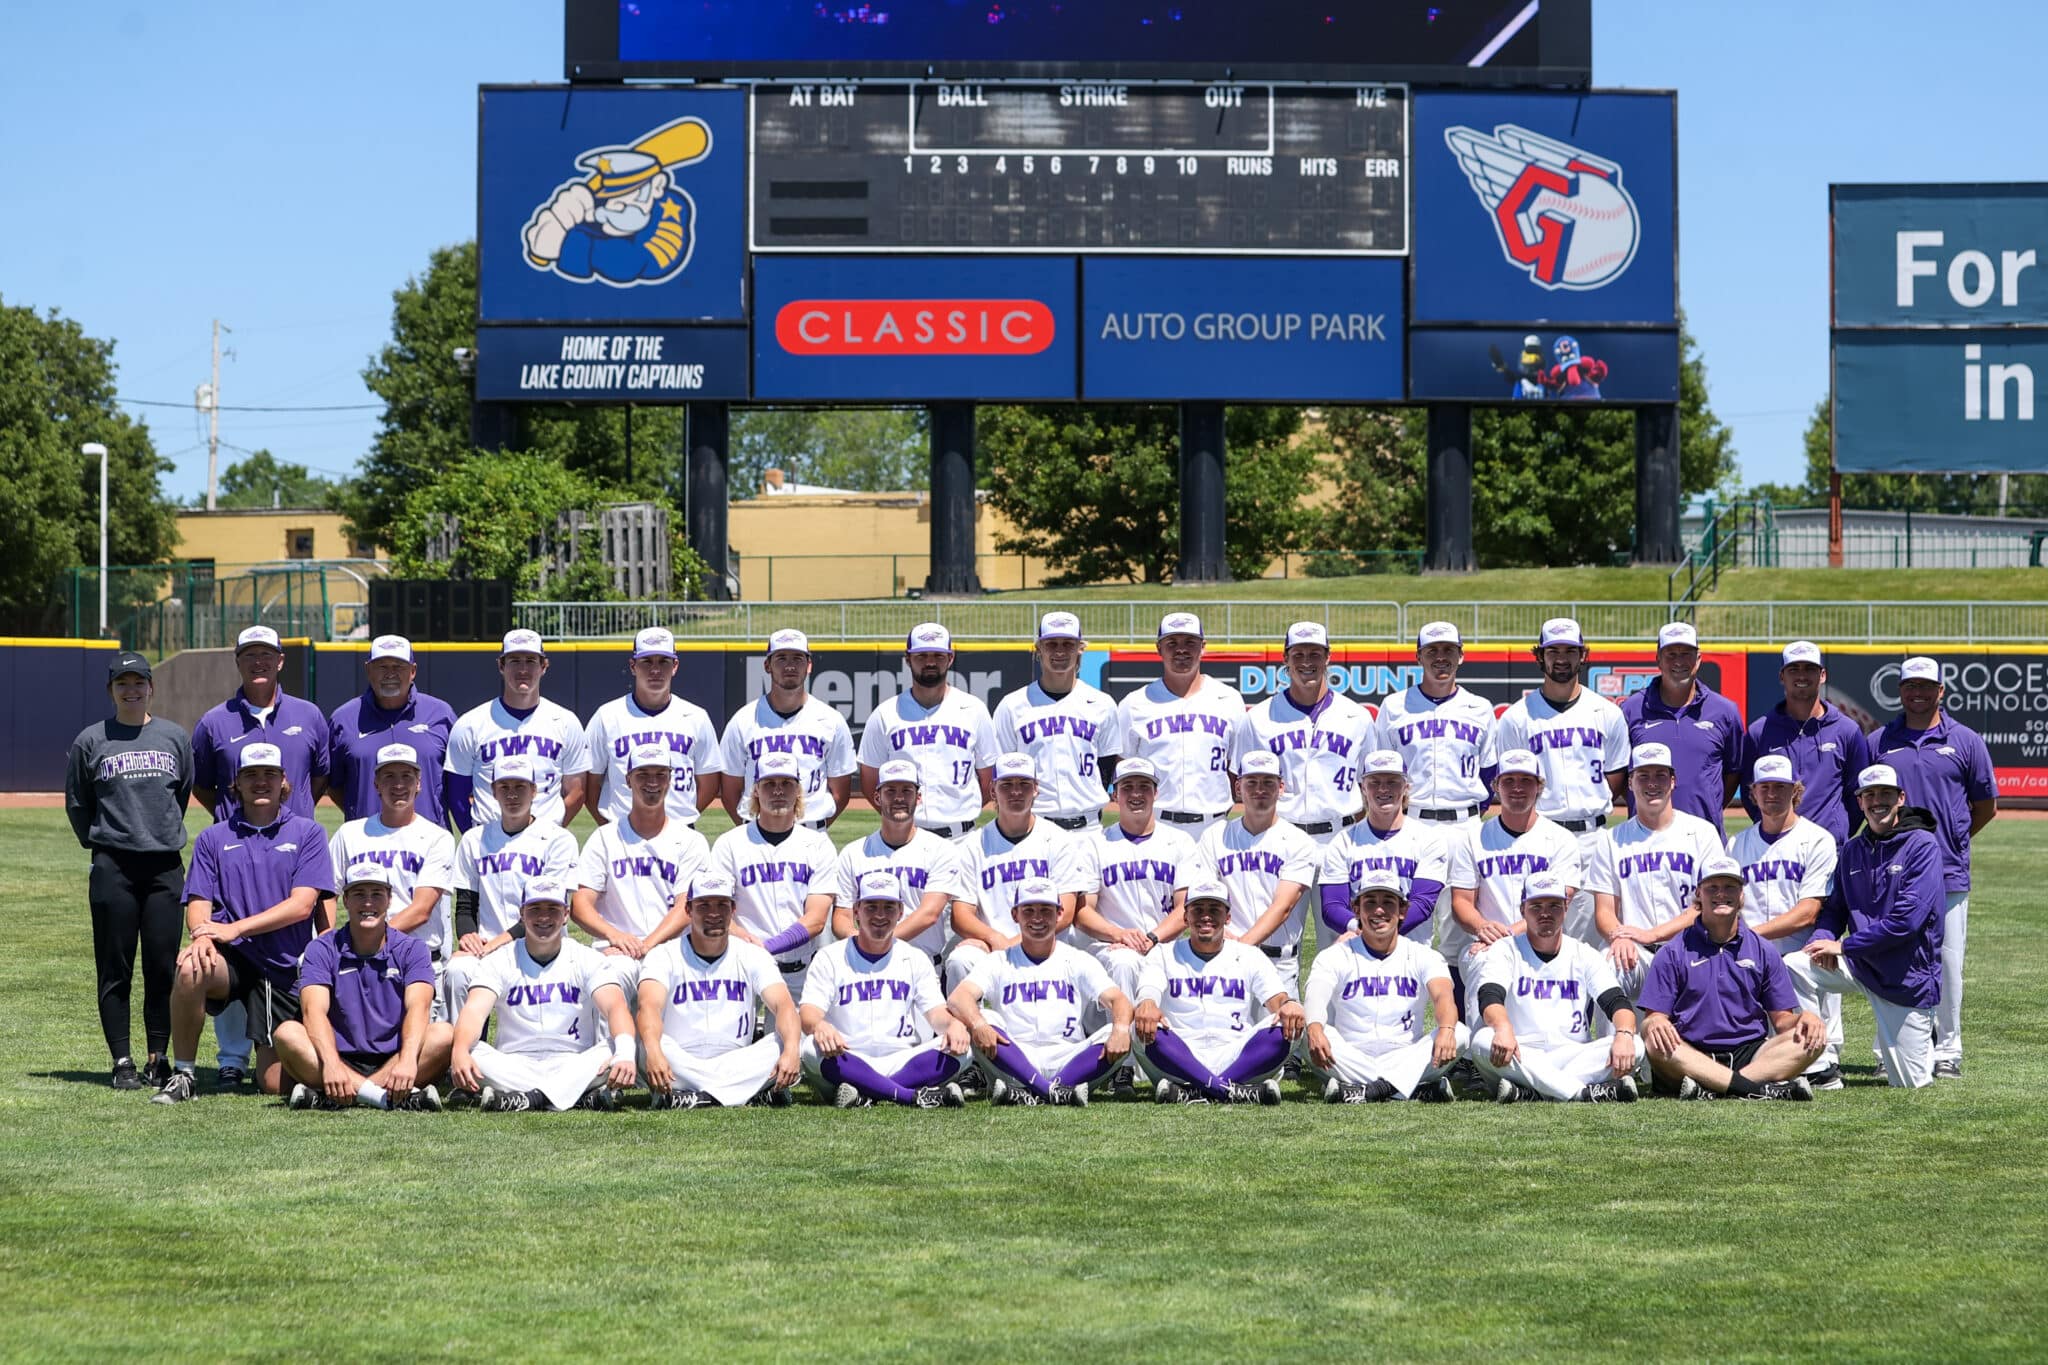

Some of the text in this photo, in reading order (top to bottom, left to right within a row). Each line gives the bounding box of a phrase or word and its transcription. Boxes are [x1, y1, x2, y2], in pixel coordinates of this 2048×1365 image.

[788, 86, 858, 106] AT BAT
[937, 86, 989, 106] BALL
[1060, 86, 1129, 107] STRIKE
[1205, 87, 1244, 107] OUT
[1356, 88, 1387, 107] H/E
[904, 156, 1400, 177] 1 2 3 4 5 6 7 8 9 10 RUNS HITS ERR
[1896, 231, 2036, 308] For
[798, 310, 1033, 344] CLASSIC
[1101, 313, 1387, 341] AUTO GROUP PARK
[561, 336, 664, 360] HOME OF THE
[520, 365, 704, 389] LAKE COUNTY CAPTAINS
[1965, 344, 2034, 421] in
[1240, 665, 1425, 695] DISOUNT
[1941, 662, 2048, 693] ROCE
[891, 725, 971, 751] UWW
[1020, 715, 1097, 744] UWW
[1146, 713, 1228, 740] UWW
[1399, 719, 1480, 747] UWW
[480, 735, 563, 763] UWW
[1269, 729, 1353, 759] UWW
[1528, 727, 1603, 754] UWW
[952, 760, 972, 785] 17
[1079, 753, 1095, 777] 16
[1590, 759, 1605, 783] 3
[1333, 766, 1356, 793] 45
[475, 852, 545, 877] UWW
[612, 856, 678, 885] UWW
[740, 861, 814, 887] UWW
[1102, 859, 1175, 888] UWW
[1218, 851, 1285, 877] UWW
[1477, 854, 1550, 879] UWW
[1618, 851, 1694, 879] UWW
[507, 982, 581, 1006] UWW
[673, 979, 747, 1005] UWW
[838, 979, 910, 1005] UWW
[1003, 980, 1075, 1004] UWW
[1169, 976, 1245, 1000] UWW
[1342, 976, 1418, 1000] UWW
[1518, 976, 1580, 1000] UWW
[568, 1017, 580, 1040] 4
[736, 1011, 749, 1038] 11
[1063, 1017, 1077, 1037] 5
[1231, 1012, 1244, 1031] 3
